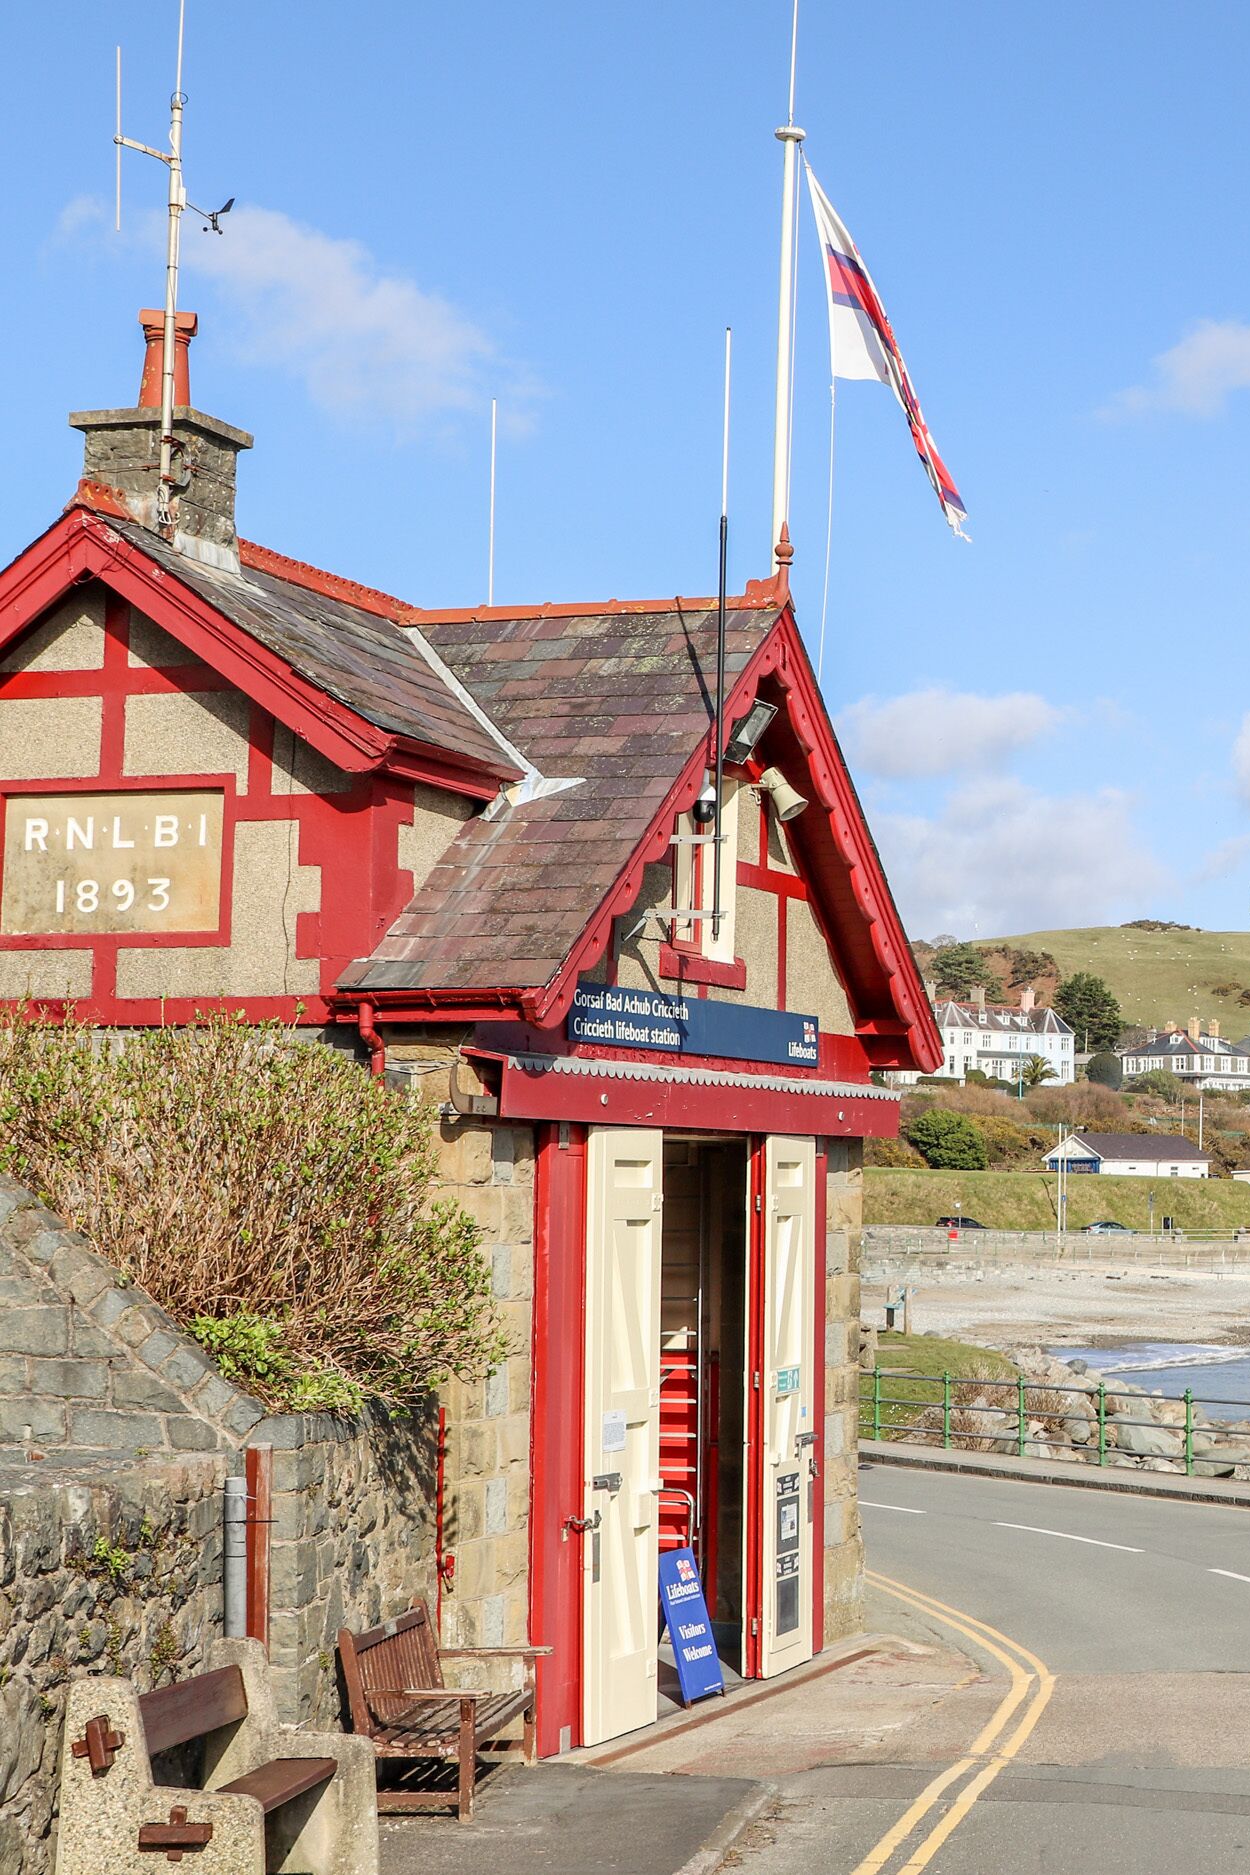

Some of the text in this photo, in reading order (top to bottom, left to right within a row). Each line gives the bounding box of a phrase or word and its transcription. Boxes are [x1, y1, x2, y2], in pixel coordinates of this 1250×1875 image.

[56, 877, 171, 913] 1893
[574, 988, 689, 1020] Gorsaf Bad Achub Criccieth
[574, 1017, 681, 1045] Criccieth lifeboat station
[788, 1042, 816, 1059] Lifeboats
[666, 1581, 699, 1600] Lifeboats
[678, 1623, 706, 1640] Visitors
[682, 1644, 713, 1663] Welcome
